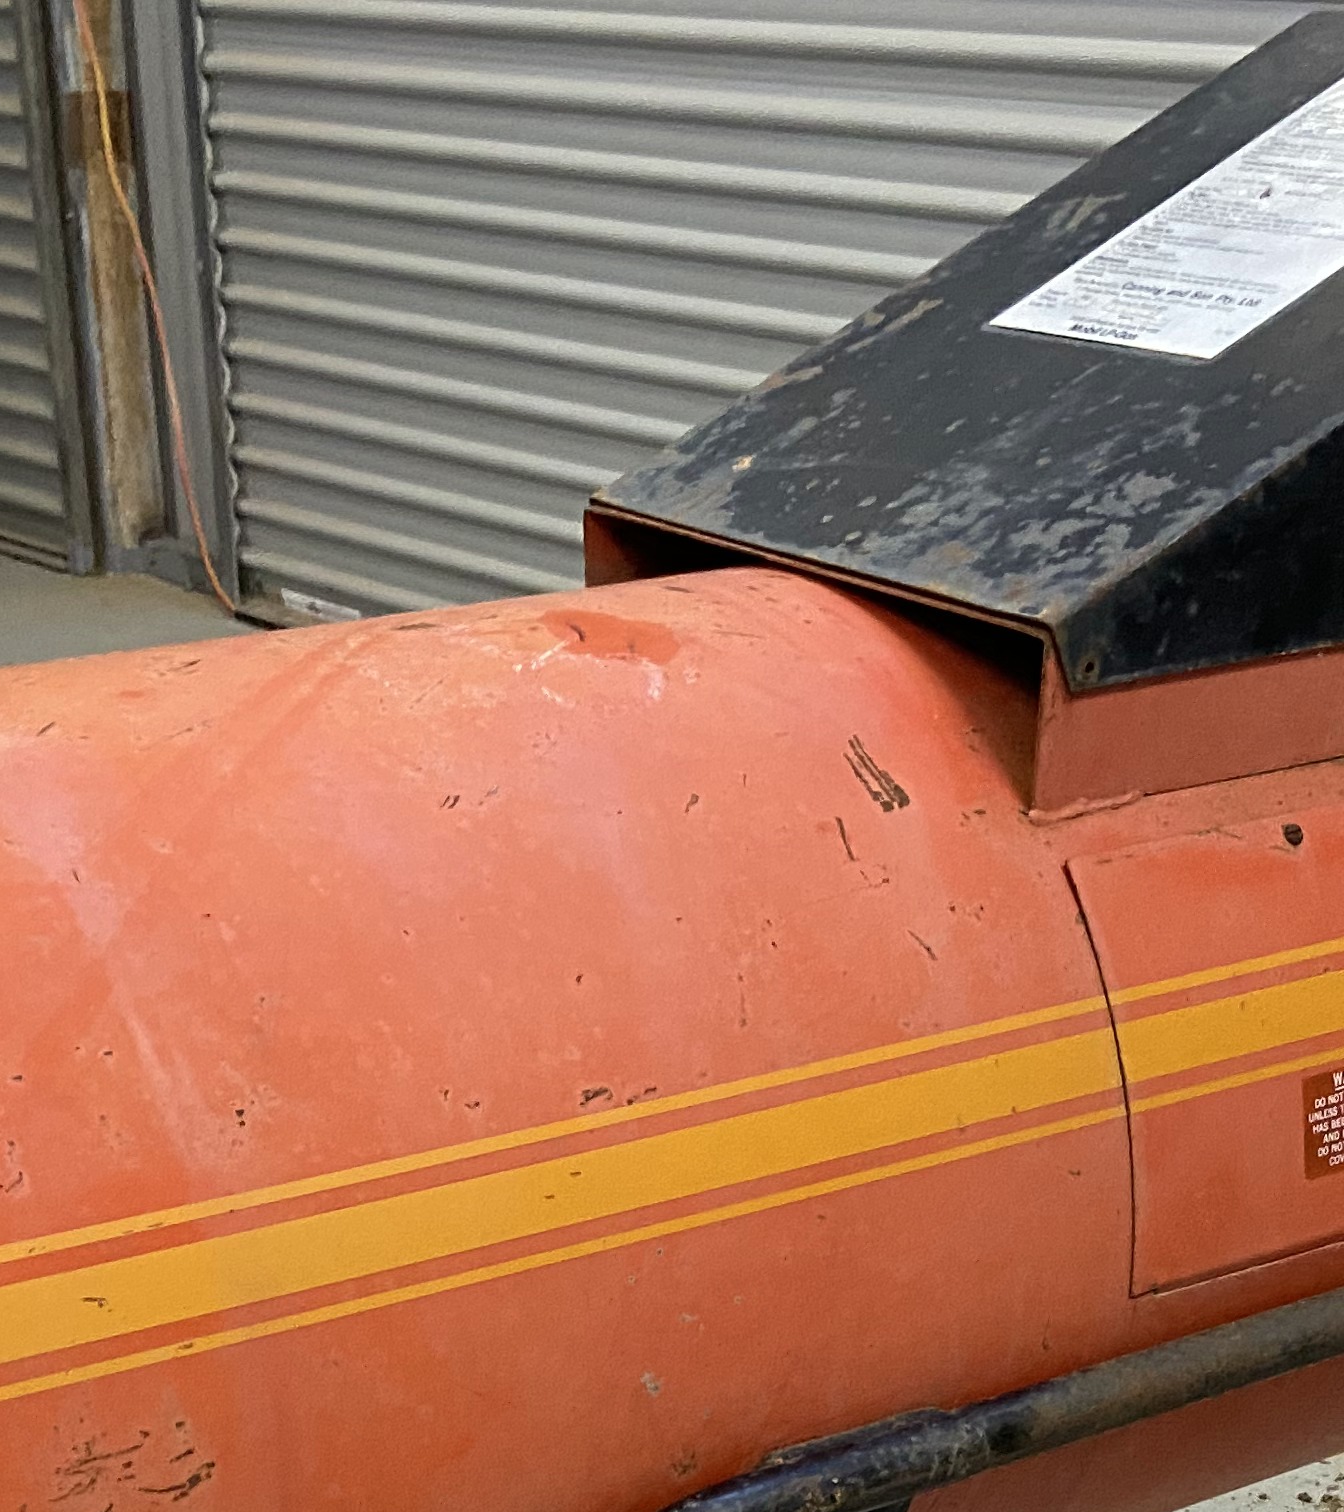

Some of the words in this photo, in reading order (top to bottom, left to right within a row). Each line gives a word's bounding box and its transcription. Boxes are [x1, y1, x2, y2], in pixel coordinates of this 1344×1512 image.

[1314, 1096, 1327, 1109] DO
[1327, 1091, 1344, 1105] NOT
[1308, 1105, 1338, 1123] UNLESS
[1312, 1121, 1329, 1135] HAS
[1323, 1131, 1340, 1144] AND
[1317, 1145, 1330, 1158] DO
